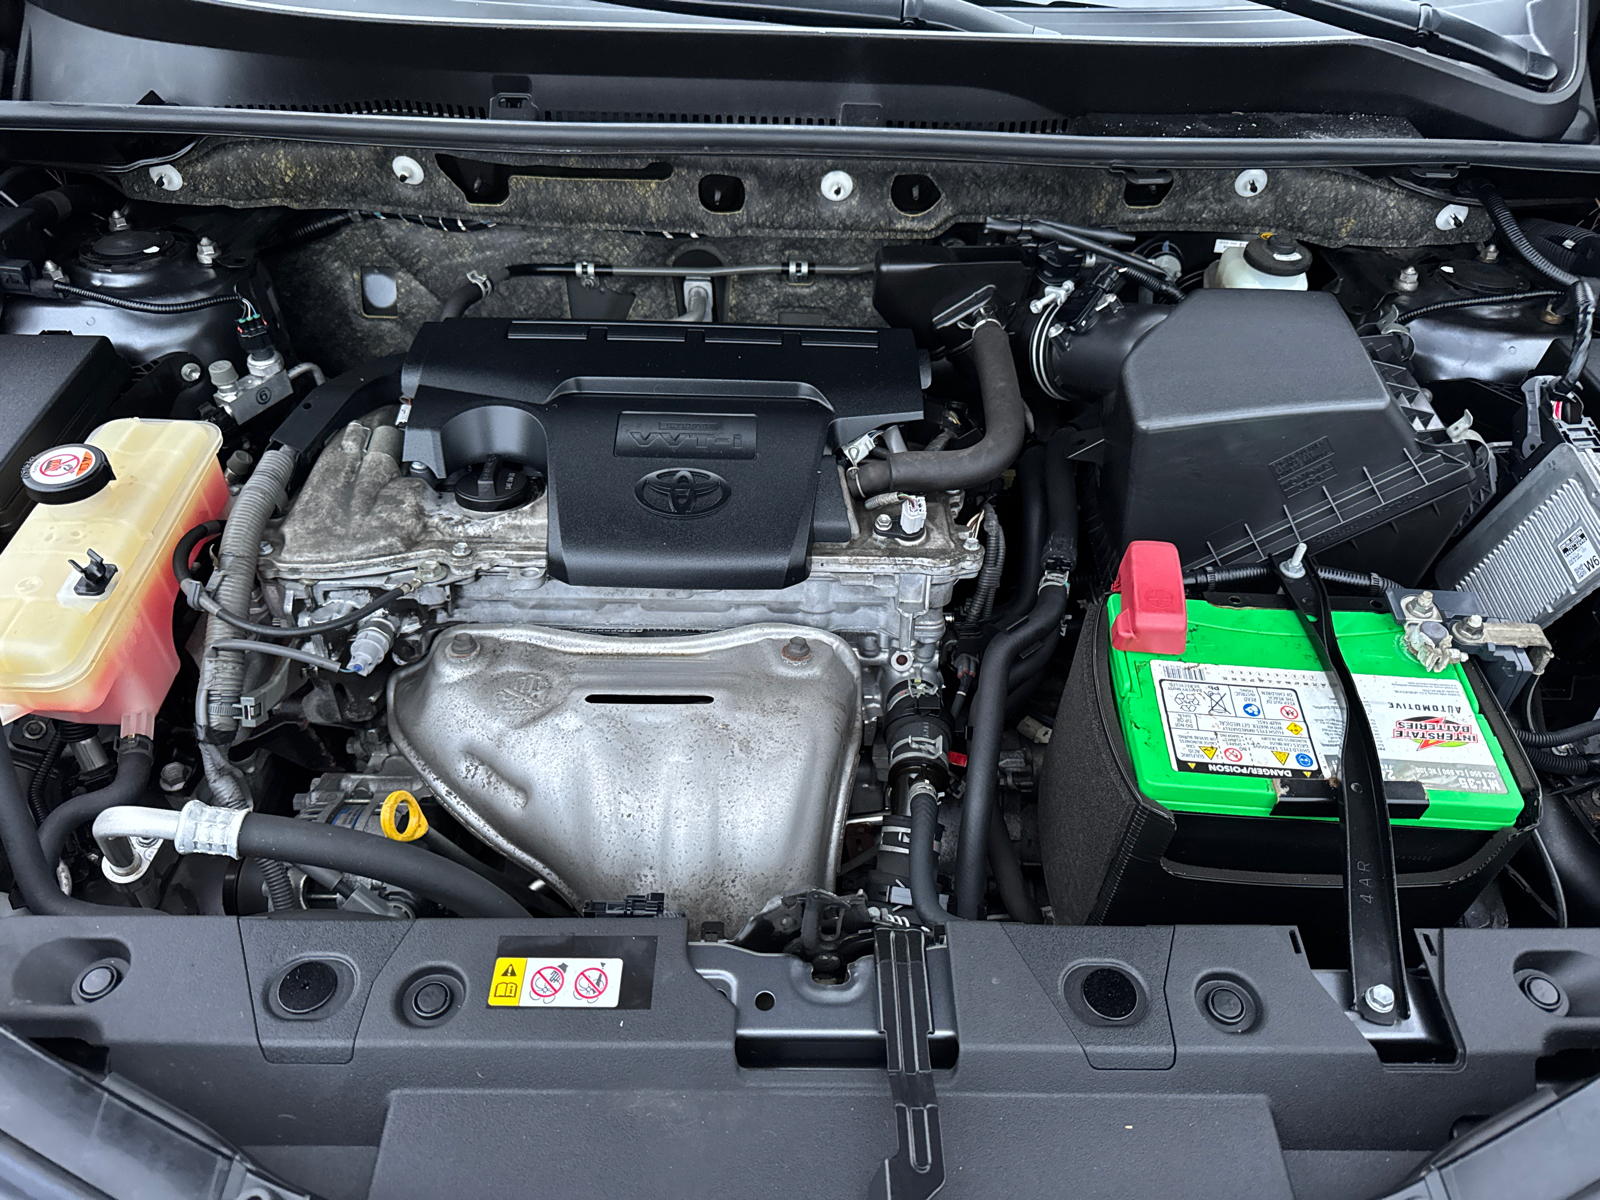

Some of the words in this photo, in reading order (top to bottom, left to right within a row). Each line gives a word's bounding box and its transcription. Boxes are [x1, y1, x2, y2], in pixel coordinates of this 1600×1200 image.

[629, 431, 743, 448] VVT-i
[1583, 555, 1600, 572] W6
[1388, 702, 1461, 714] AUTOMOTIVE
[1397, 721, 1471, 733] BATTERIES
[1395, 730, 1477, 742] INTERSTATE
[1208, 764, 1292, 777] DANGER/POISON
[1454, 768, 1464, 776] CA
[1482, 770, 1497, 778] CCA
[1458, 777, 1500, 791] MT-35
